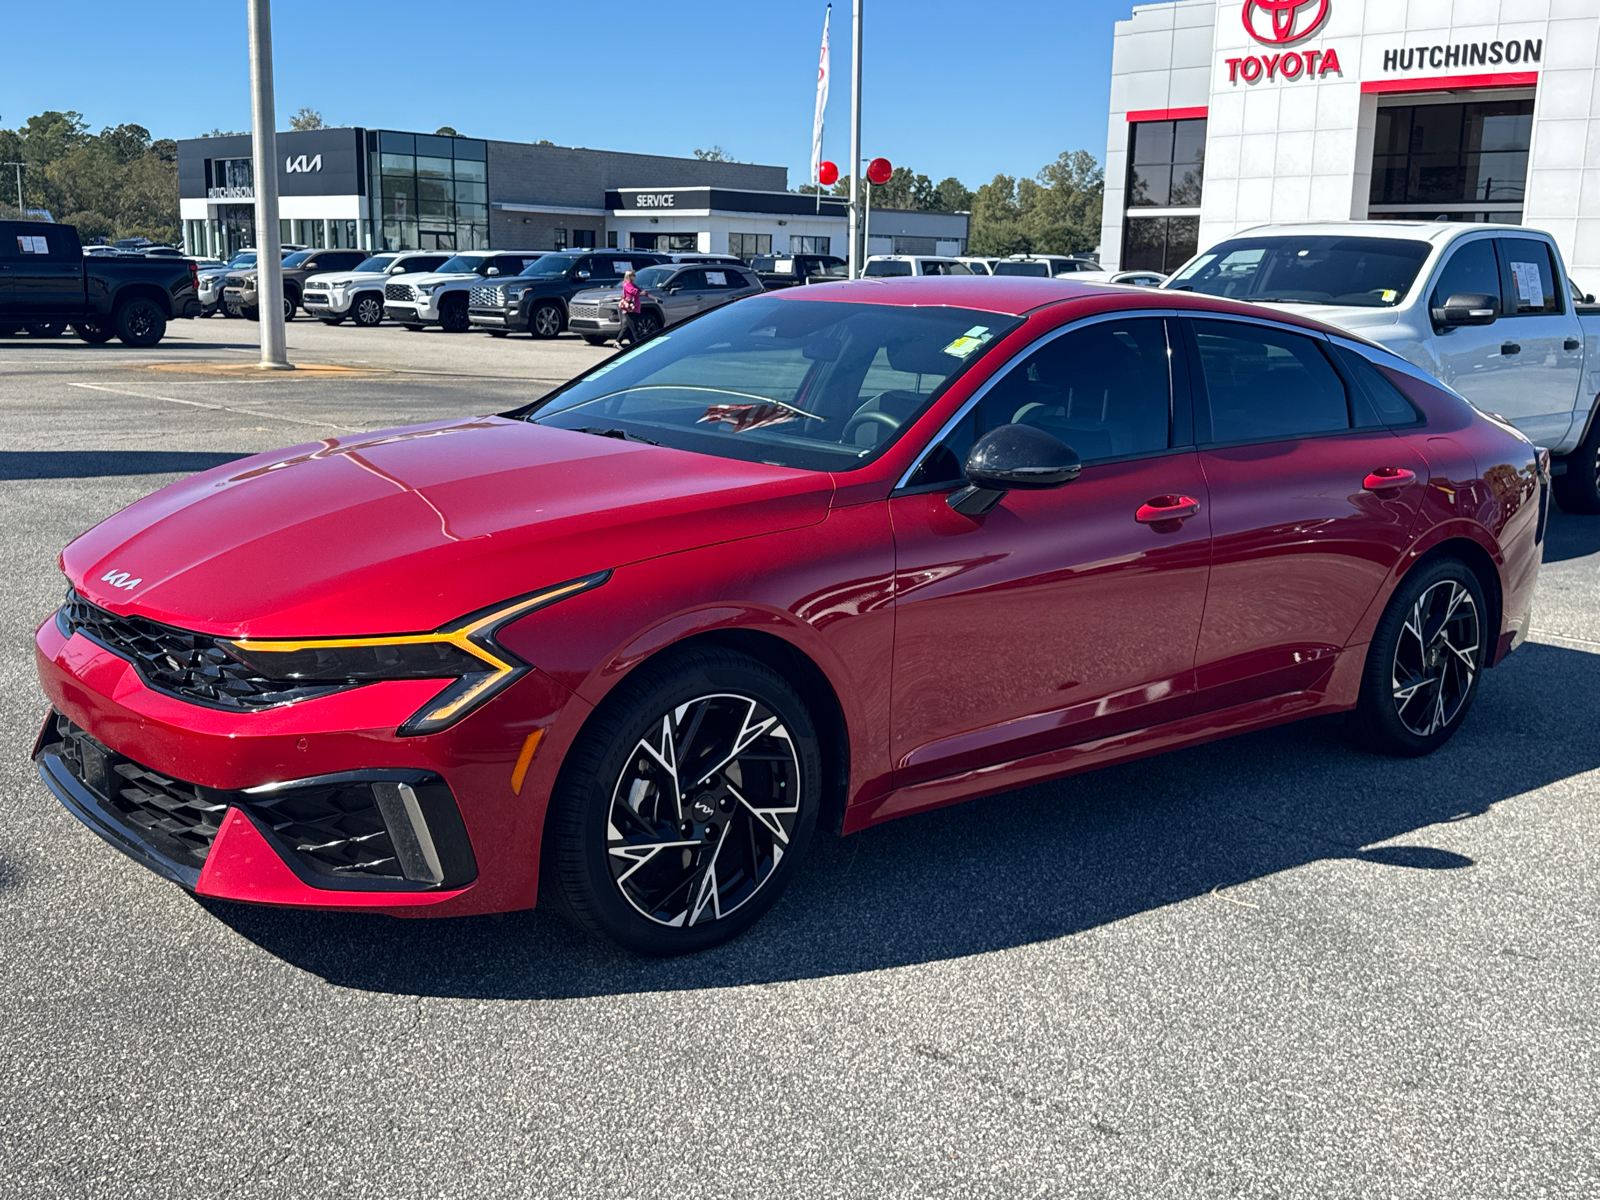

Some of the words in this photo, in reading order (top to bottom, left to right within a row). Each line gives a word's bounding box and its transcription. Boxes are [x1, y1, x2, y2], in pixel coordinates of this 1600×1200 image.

[1383, 38, 1543, 71] HUTCHINSON
[1225, 48, 1341, 82] TOYOTA
[286, 154, 322, 173] KIA
[208, 187, 254, 198] HUTCHINSON
[636, 194, 675, 207] SERVICE
[101, 569, 143, 591] KIA
